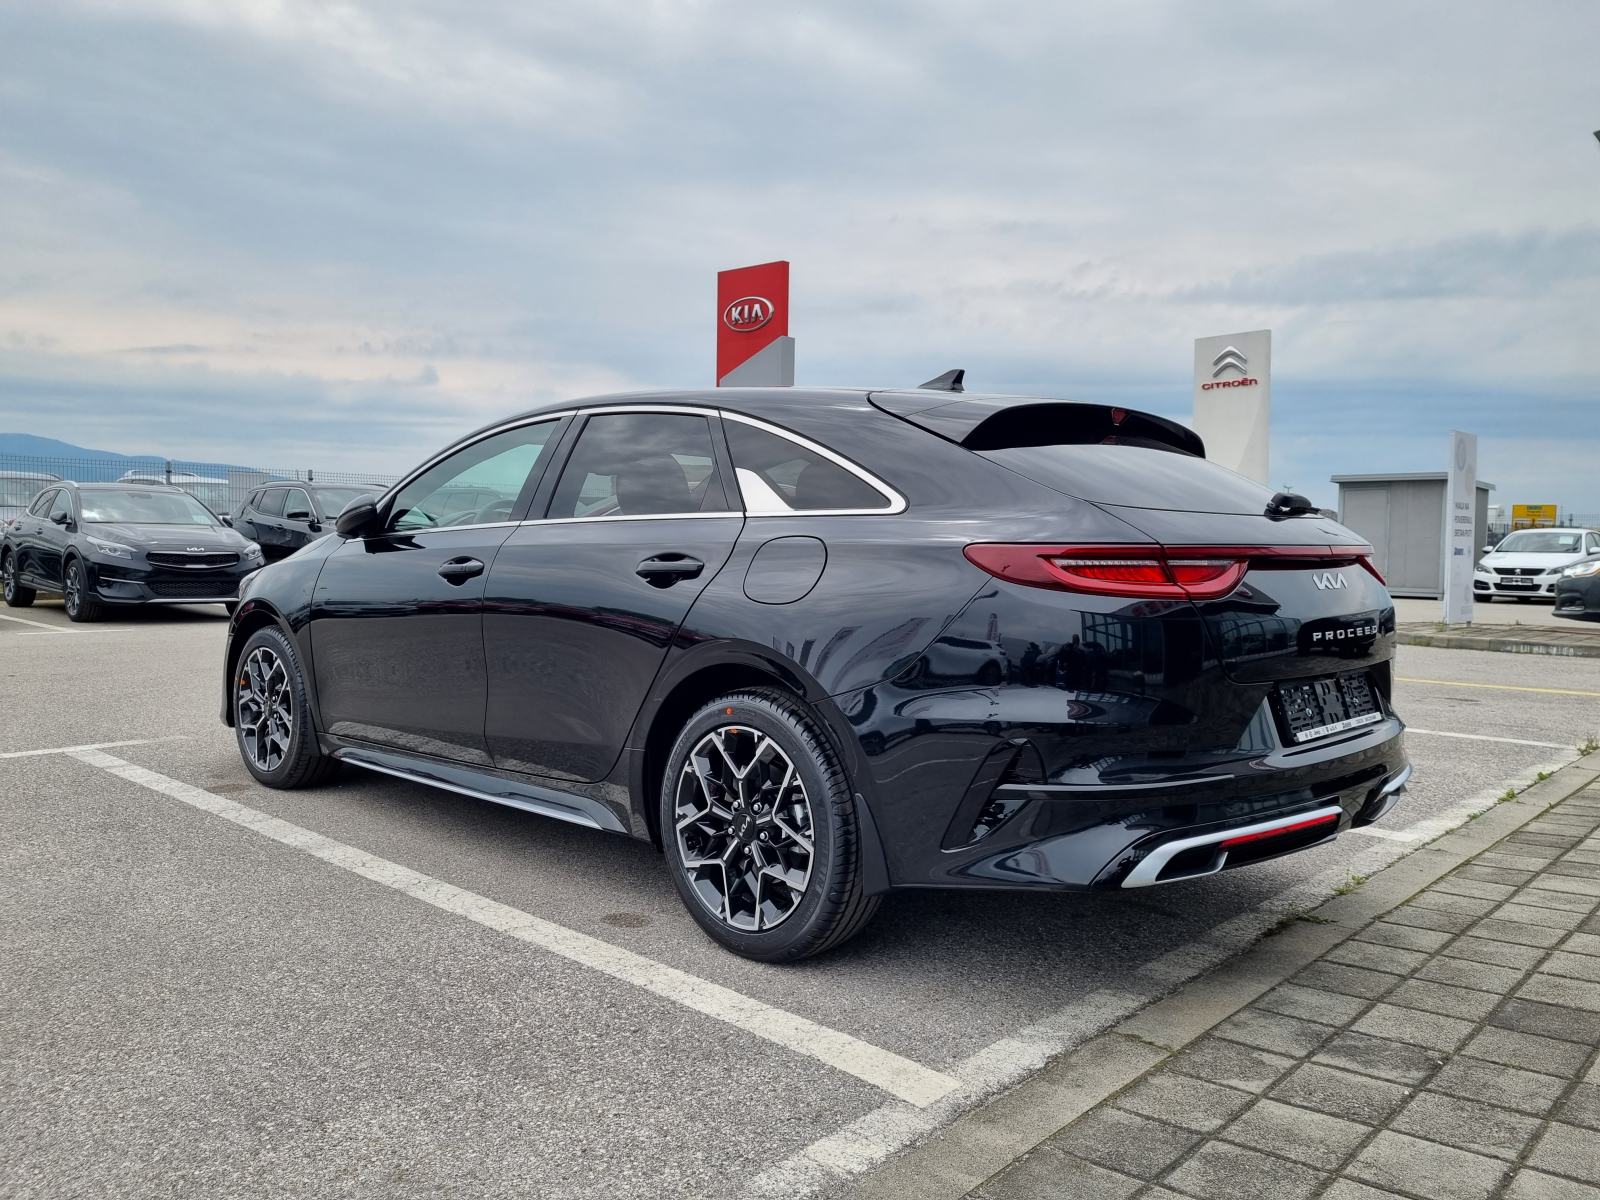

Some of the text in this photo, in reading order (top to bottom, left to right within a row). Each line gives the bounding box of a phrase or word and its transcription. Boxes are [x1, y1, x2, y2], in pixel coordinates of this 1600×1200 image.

[731, 303, 764, 324] KIA
[1312, 572, 1348, 590] KIA
[1312, 625, 1378, 641] PROCEED
